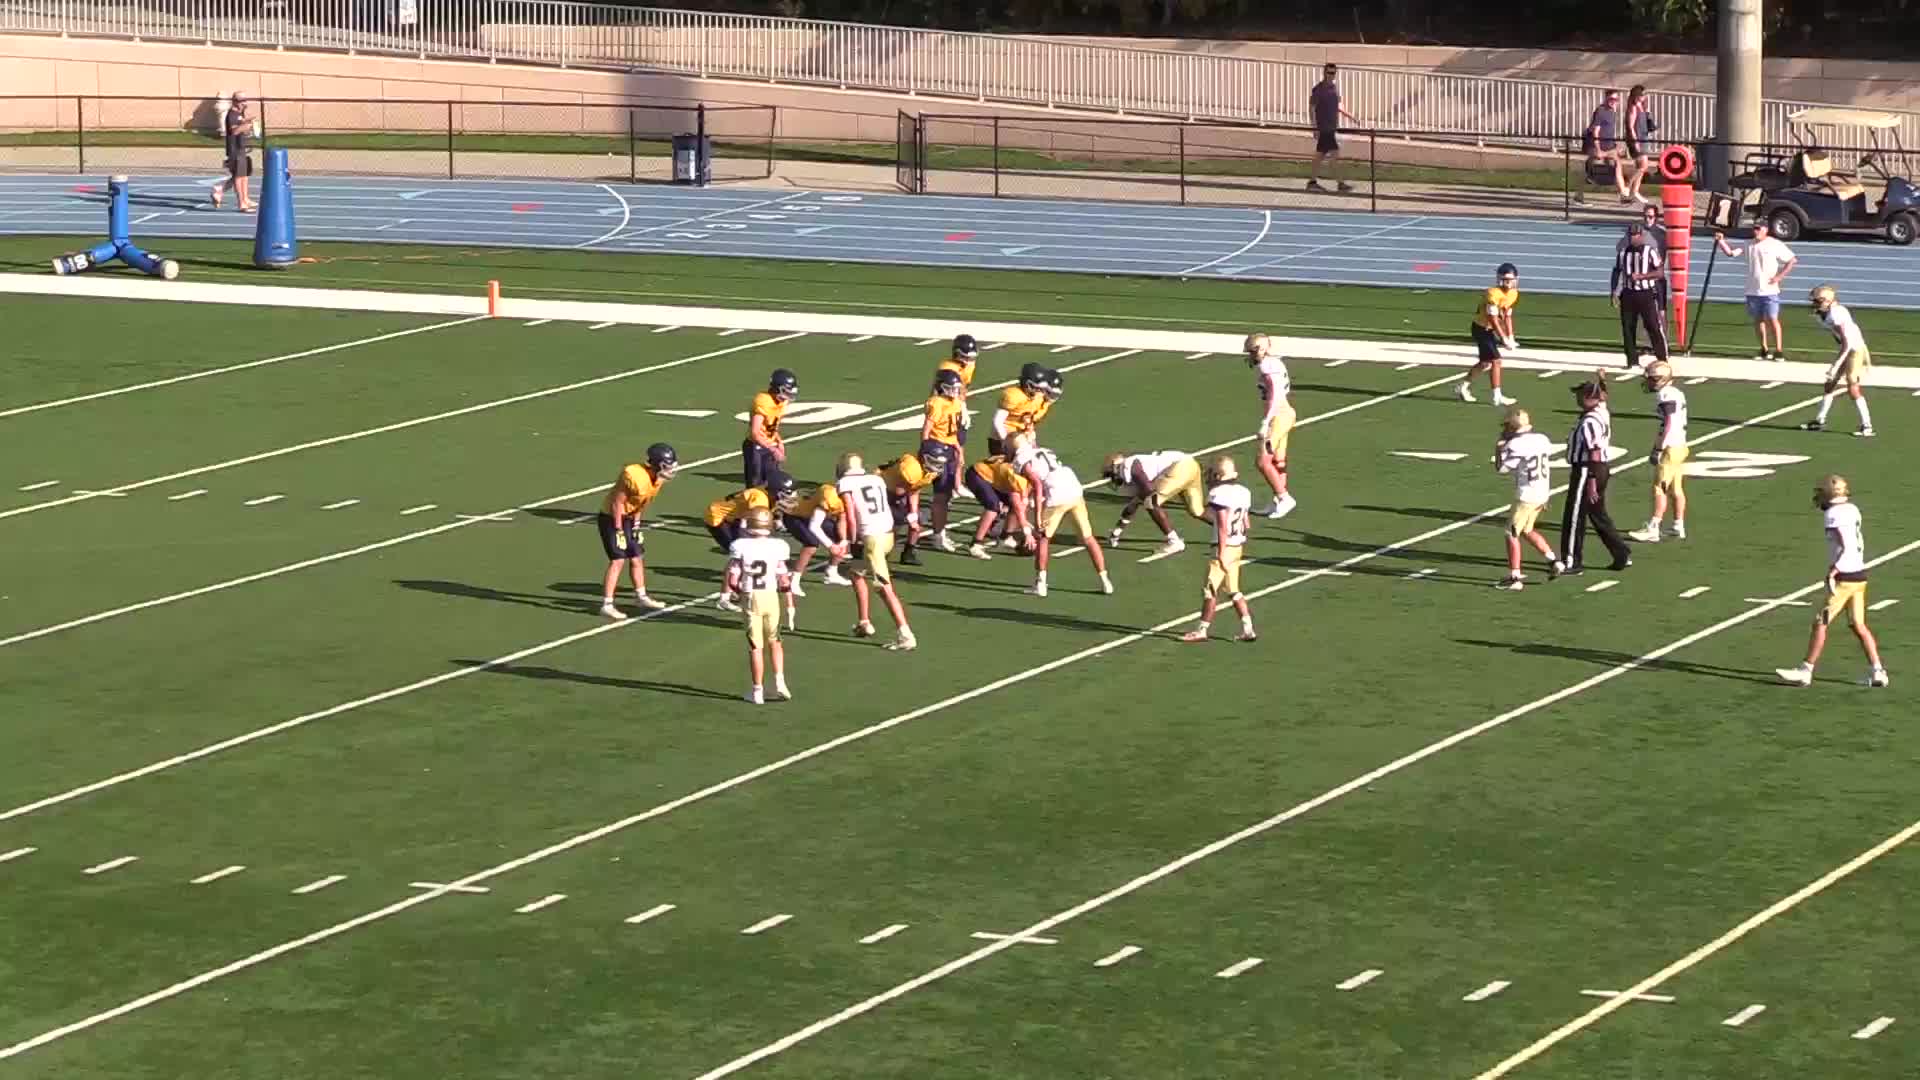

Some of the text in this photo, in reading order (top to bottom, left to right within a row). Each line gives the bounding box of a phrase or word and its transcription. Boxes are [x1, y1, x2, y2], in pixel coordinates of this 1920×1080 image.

[1716, 199, 1732, 226] 1
[860, 485, 885, 514] 51
[751, 560, 767, 590] 2
